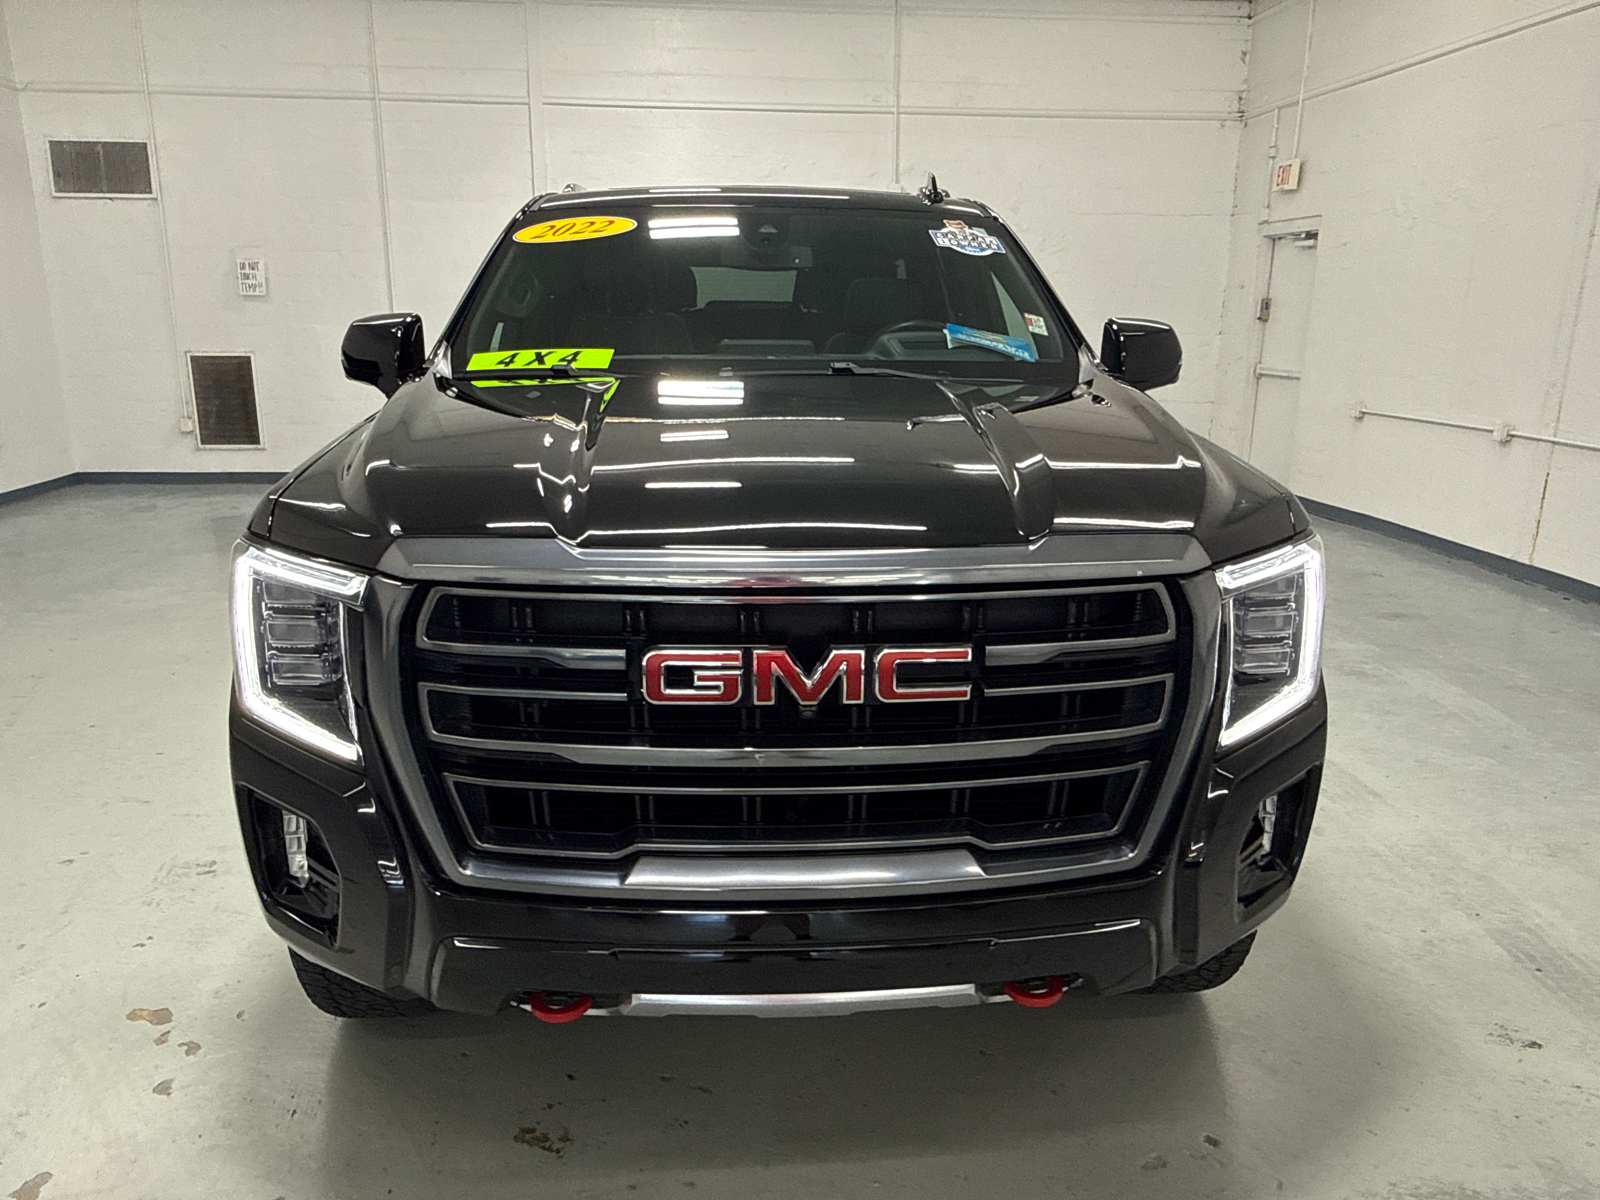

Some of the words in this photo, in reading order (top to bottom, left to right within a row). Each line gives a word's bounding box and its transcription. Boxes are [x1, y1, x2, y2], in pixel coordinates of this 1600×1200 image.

[1276, 164, 1292, 186] EXIT
[529, 220, 615, 239] 2022
[239, 261, 246, 271] DO
[247, 261, 260, 271] NOT
[642, 648, 973, 705] GMC
